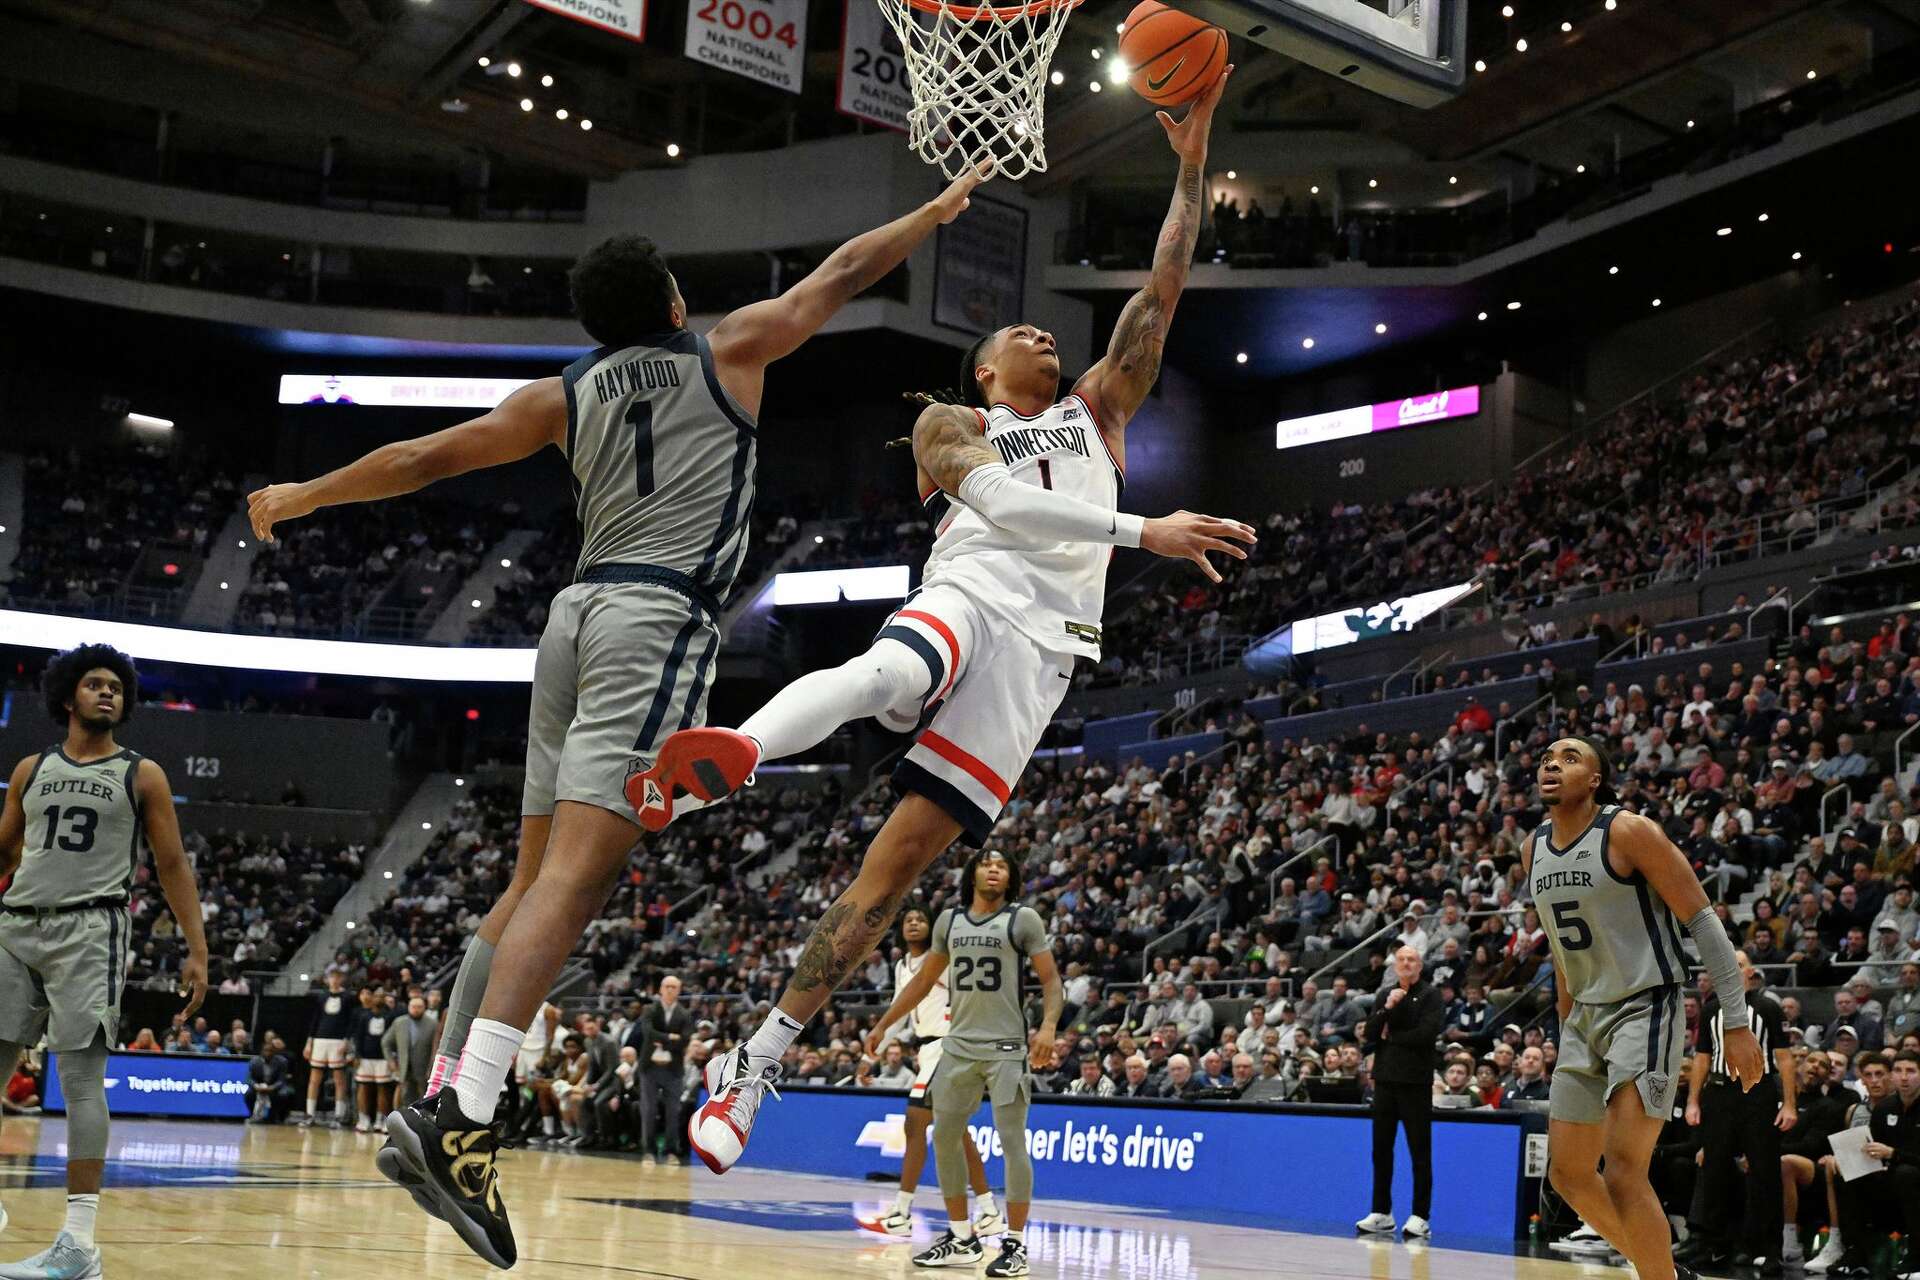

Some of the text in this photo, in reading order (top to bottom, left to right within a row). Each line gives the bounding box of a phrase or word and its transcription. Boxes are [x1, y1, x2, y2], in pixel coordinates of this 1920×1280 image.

[559, 0, 627, 27] MPIONS
[697, 0, 798, 49] 2004
[698, 46, 791, 86] CHAMPIONS
[705, 30, 786, 66] NATIONAL
[594, 359, 681, 404] HAYWOOD
[625, 401, 655, 498] 1
[990, 425, 1091, 467] ONNECTICUT
[1037, 458, 1053, 491] 1
[1339, 458, 1365, 478] 200
[185, 756, 220, 778] 123
[39, 779, 114, 802] BUTLER
[42, 804, 99, 852] 13
[1536, 870, 1594, 895] BUTLER
[952, 936, 1002, 949] BUTLER
[1551, 900, 1593, 951] 5
[953, 956, 1002, 992] 23
[127, 1076, 250, 1094] Together let's driv
[1062, 1120, 1118, 1166] let's
